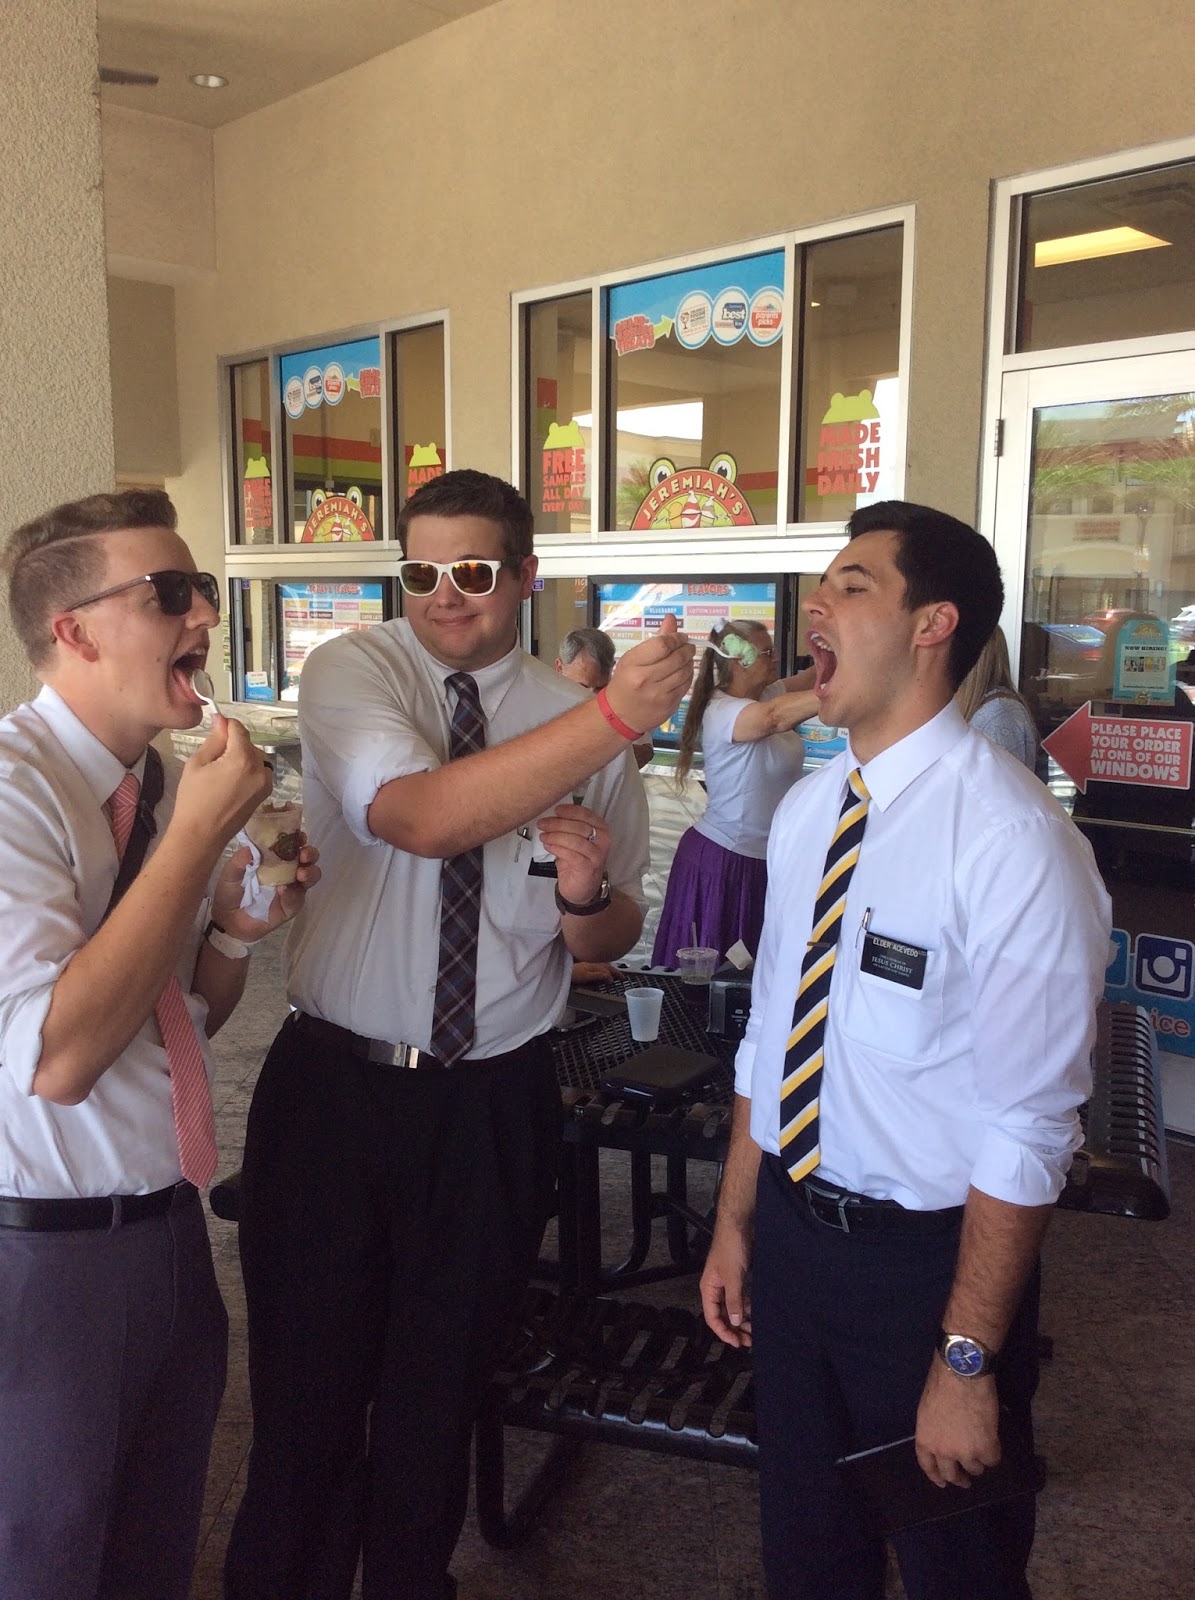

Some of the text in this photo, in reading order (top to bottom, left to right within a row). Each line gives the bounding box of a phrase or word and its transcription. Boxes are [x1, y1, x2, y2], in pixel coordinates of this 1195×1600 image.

[723, 308, 746, 320] best
[820, 422, 881, 449] MADE
[543, 448, 585, 474] FREE
[817, 446, 880, 473] FRESH
[543, 473, 586, 487] SAMPLES
[817, 471, 880, 496] DAILY
[543, 486, 585, 500] ALL DAY
[642, 474, 743, 520] JEREMIAH'S
[308, 501, 368, 535] JEREMIAH'S
[687, 583, 729, 596] FLAVORS
[1091, 723, 1182, 740] PLEASE PLACE
[1091, 735, 1181, 753] YOUR ORDER
[1090, 748, 1181, 765] AT ONE OF OUR
[1090, 759, 1180, 782] WINDOWS
[873, 937, 919, 958] ELDER ACEVEDO
[871, 956, 889, 967] JESUS
[889, 962, 914, 974] CHRIST
